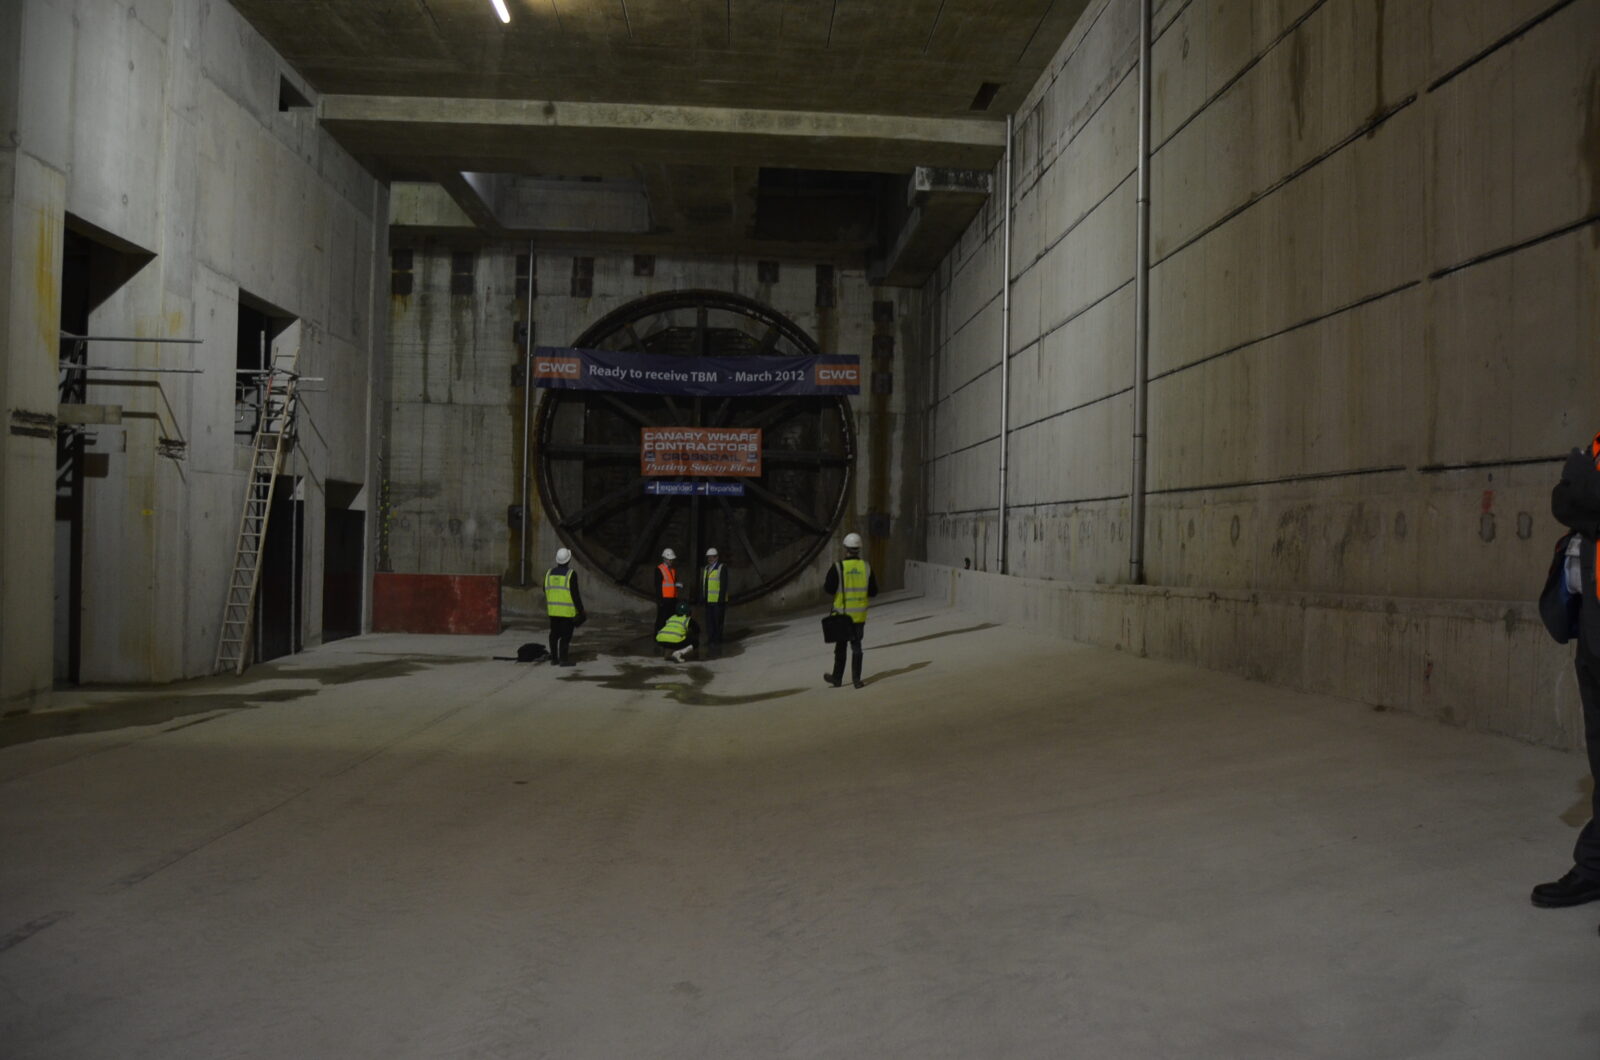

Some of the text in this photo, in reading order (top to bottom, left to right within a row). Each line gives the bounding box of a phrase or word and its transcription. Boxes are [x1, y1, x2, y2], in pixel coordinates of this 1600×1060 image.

[538, 362, 577, 374] CWC
[589, 364, 627, 380] Ready
[630, 368, 643, 379] to
[645, 369, 689, 382] receive
[690, 371, 717, 382] TBM
[735, 370, 772, 382] March
[775, 370, 805, 381] 2012
[819, 369, 858, 380] CWC
[644, 432, 758, 442] CANARY WHARF
[644, 442, 758, 451] CONTRACTORS
[646, 463, 756, 473] Putting Safety First
[710, 485, 743, 493] expanded
